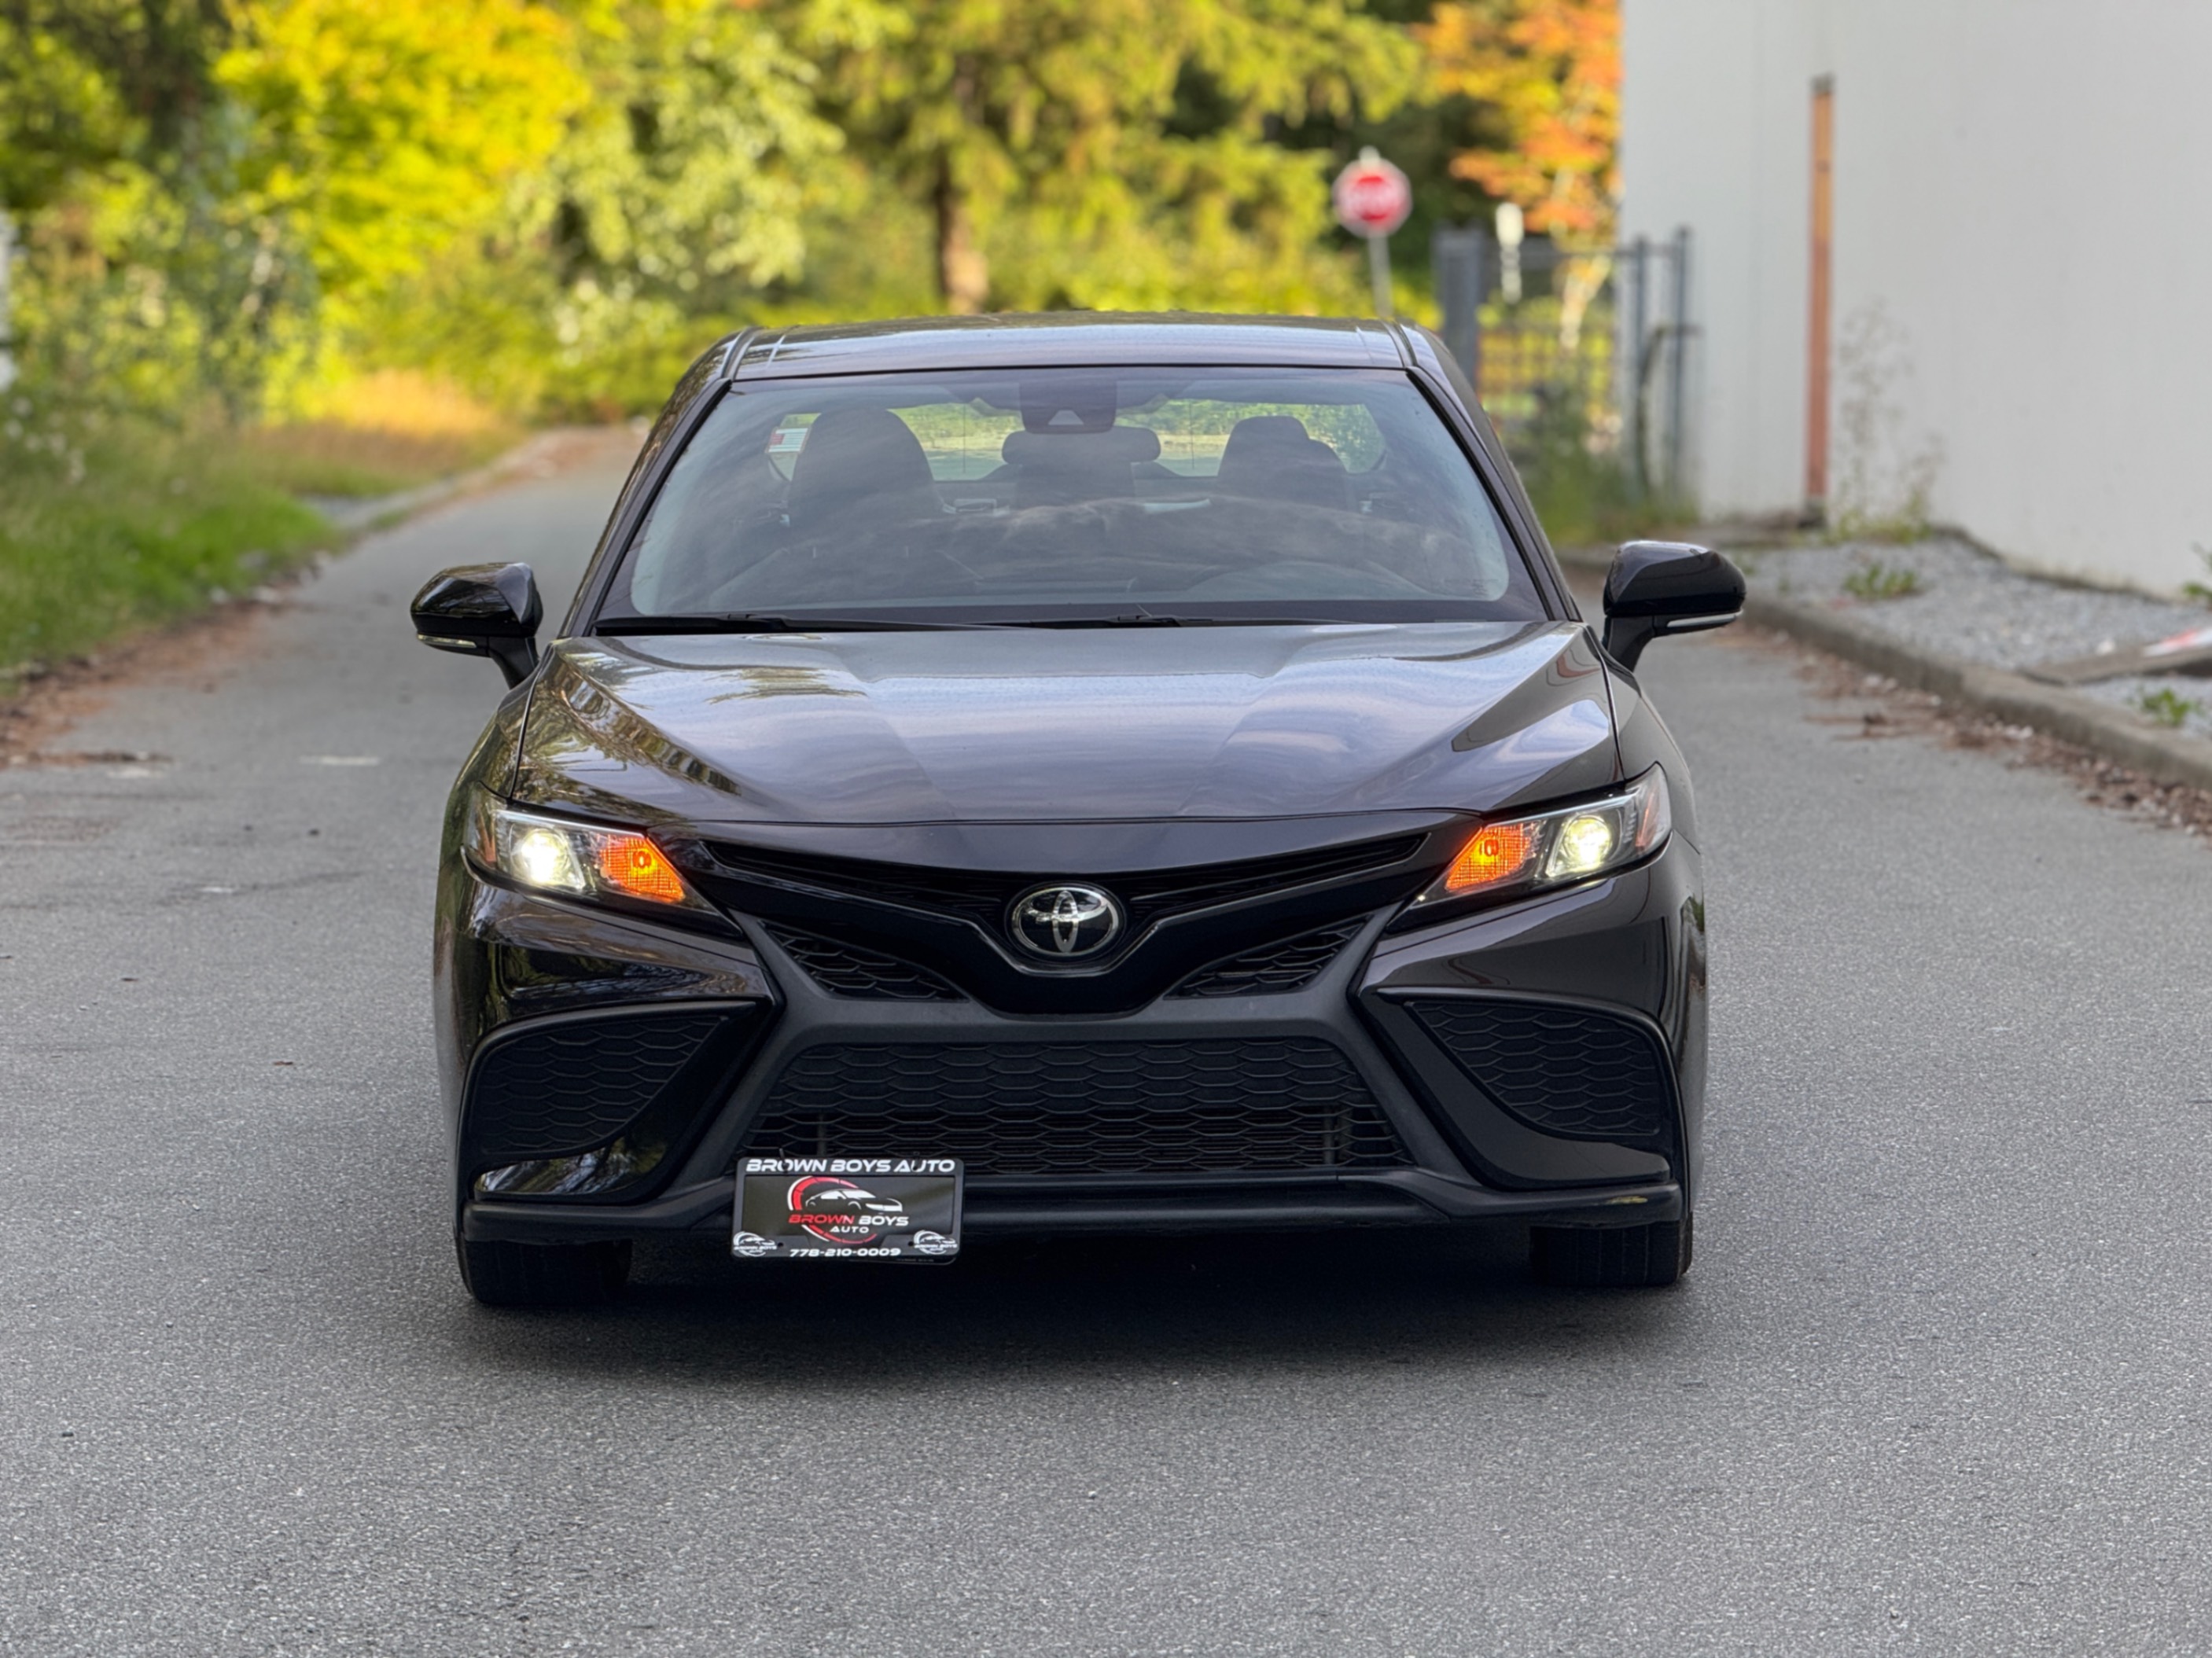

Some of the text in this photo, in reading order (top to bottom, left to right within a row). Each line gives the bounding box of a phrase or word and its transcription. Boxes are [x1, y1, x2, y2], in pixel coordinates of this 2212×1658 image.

[745, 1159, 955, 1172] BROWN BOYS AUTO
[788, 1214, 909, 1226] BROWN BOYS
[789, 1248, 901, 1257] 778-210-0009
